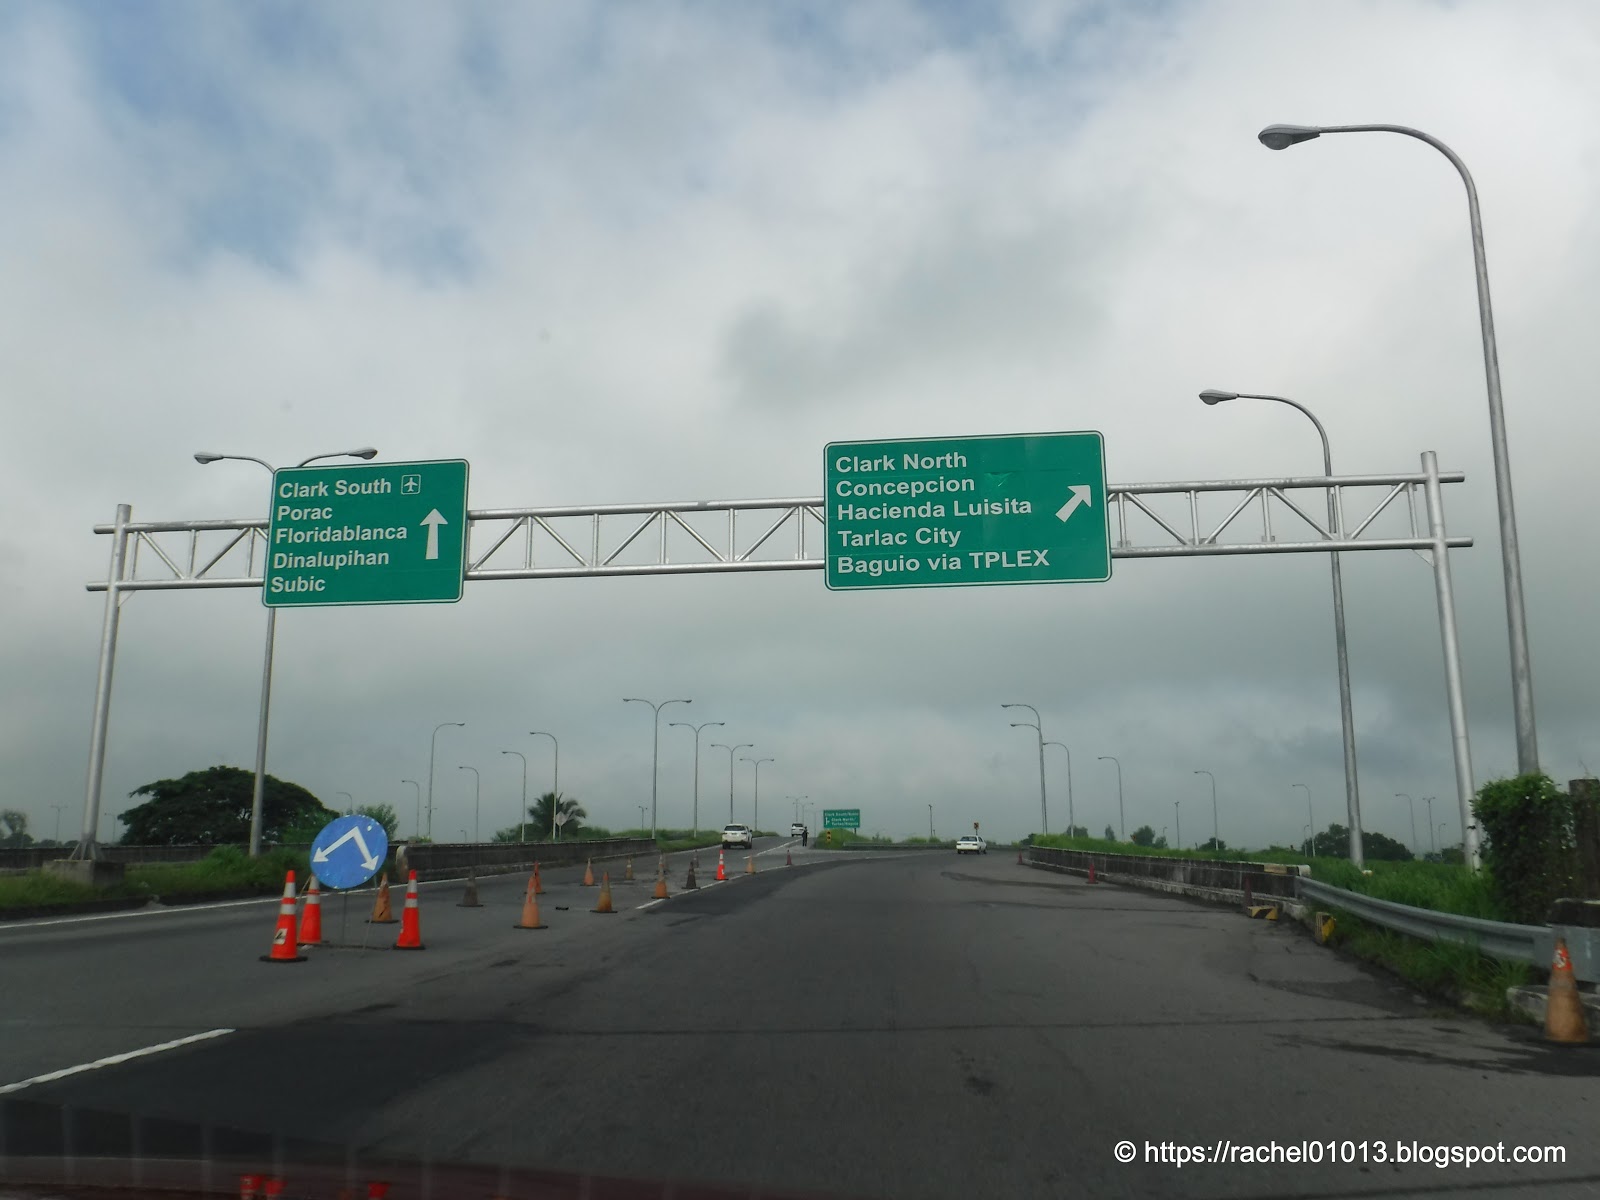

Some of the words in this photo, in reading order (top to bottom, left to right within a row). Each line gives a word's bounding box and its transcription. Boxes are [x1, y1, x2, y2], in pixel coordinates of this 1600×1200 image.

[835, 456, 895, 473] Clark
[903, 452, 967, 470] North
[279, 482, 328, 498] Clark
[335, 479, 391, 495] South
[836, 477, 974, 497] Concepcion
[278, 506, 332, 521] Porac
[838, 502, 945, 520] Hacienda
[954, 499, 1032, 517] Luisita
[276, 526, 407, 544] Floridablanca
[838, 530, 907, 547] Tarlac
[915, 527, 961, 547] City
[274, 551, 389, 570] Dinalupihan
[838, 555, 920, 577] Baguio
[927, 554, 961, 570] via
[969, 549, 1050, 568] TPLEX
[271, 576, 326, 593] Subic
